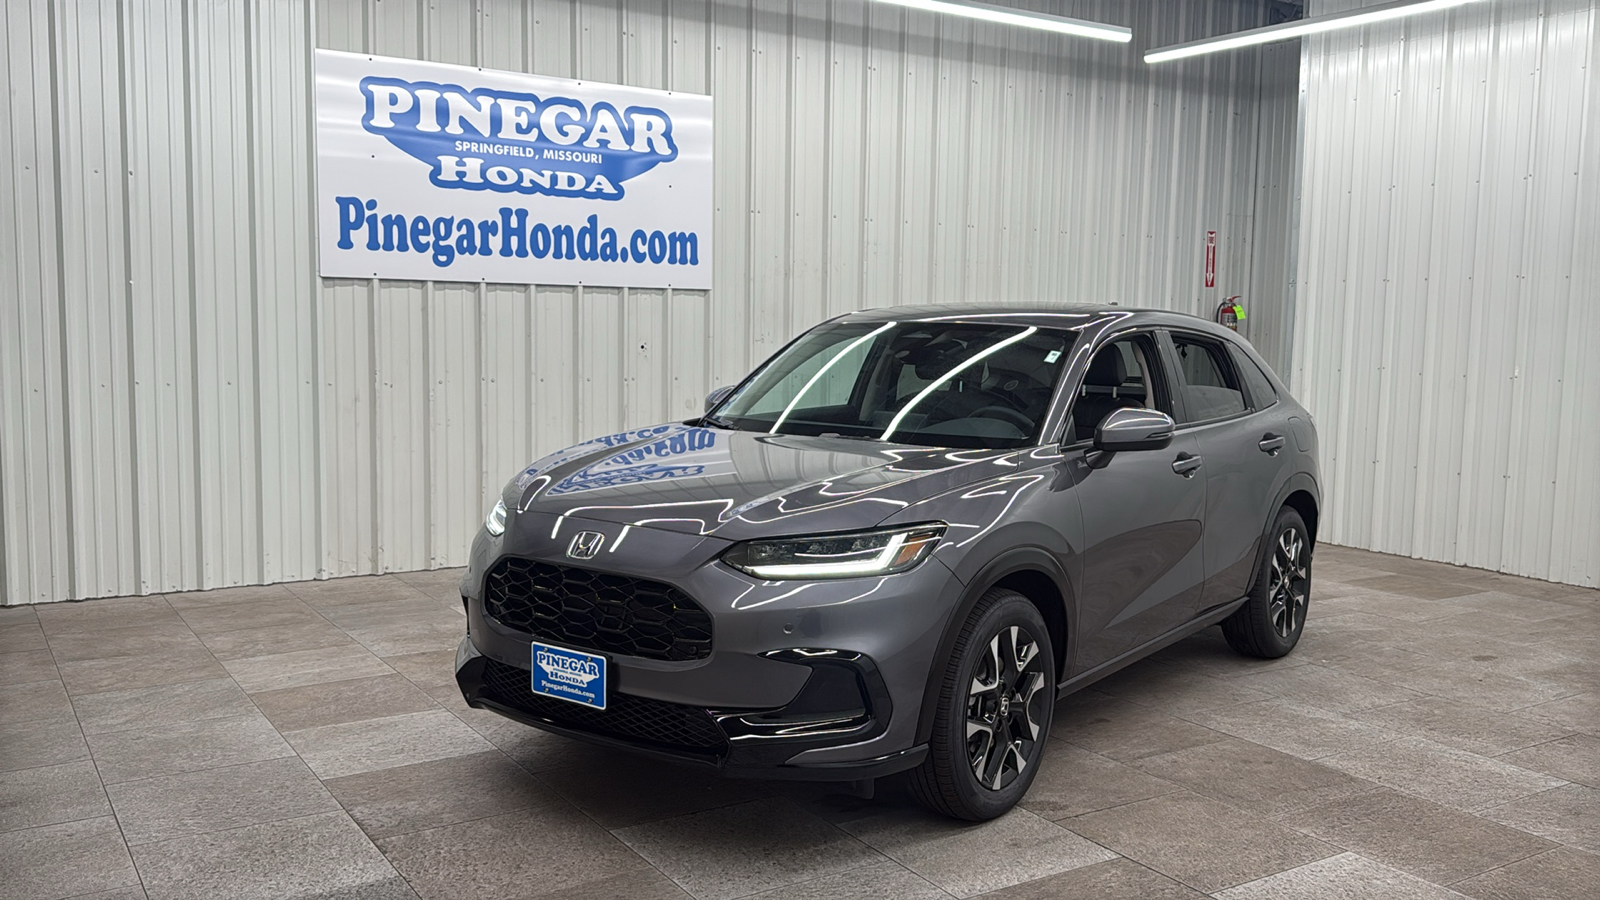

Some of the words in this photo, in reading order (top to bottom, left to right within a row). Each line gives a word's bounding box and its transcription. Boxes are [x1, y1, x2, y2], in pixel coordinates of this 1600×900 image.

[367, 84, 673, 156] PINEGAR
[454, 140, 540, 161] SPRINGFIELD,
[542, 148, 603, 164] MISSOURI
[436, 155, 619, 196] HONDA
[335, 196, 700, 268] PinegarHonda.com
[538, 652, 599, 677] PINEGAR
[541, 679, 596, 699] PinegarHonda.com
[549, 671, 586, 686] HONDA
